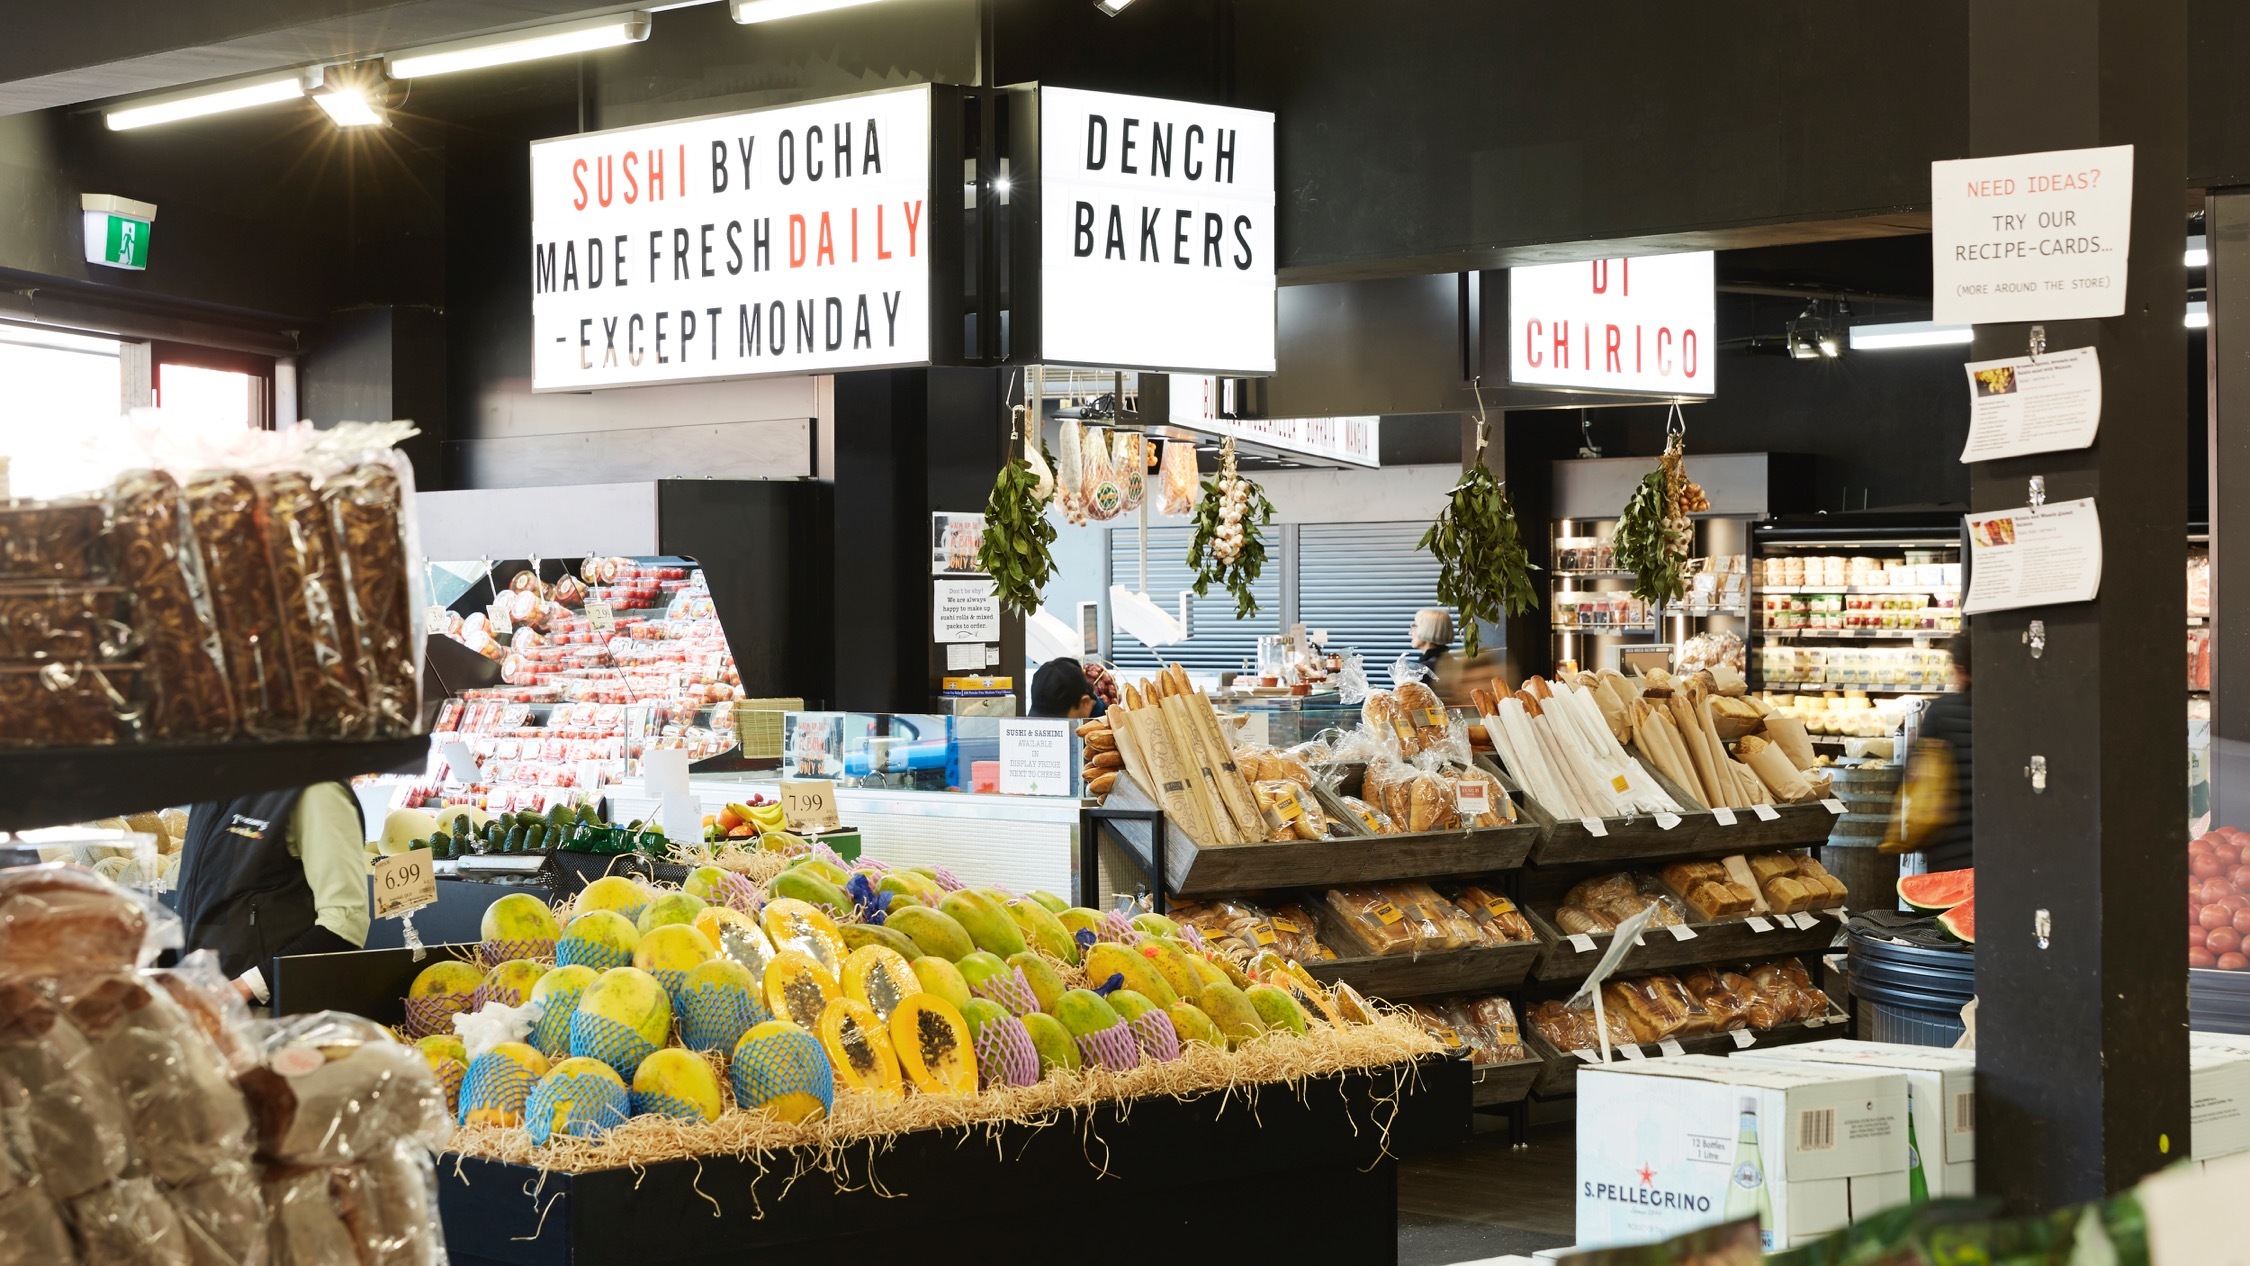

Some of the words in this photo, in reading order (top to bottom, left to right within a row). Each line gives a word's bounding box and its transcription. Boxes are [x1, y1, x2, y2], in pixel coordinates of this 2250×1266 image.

[1086, 113, 1235, 184] DENCH
[573, 143, 687, 212] SUSHI
[712, 135, 756, 194] BY
[777, 117, 882, 185] OCHA
[1967, 179, 2015, 198] NEED
[2027, 169, 2101, 193] IDEAS?
[1992, 214, 2027, 231] TRY
[2038, 210, 2076, 229] OUR
[1073, 200, 1253, 271] BAKERS
[536, 233, 628, 295] MADE
[650, 213, 772, 284] FRESH
[788, 200, 924, 269] DAILY
[1956, 284, 1989, 297] (MORE
[1994, 282, 2037, 293] AROUND
[2044, 280, 2064, 290] THE
[2072, 276, 2111, 290] STORE)
[739, 290, 900, 358] MONDAY
[1526, 317, 1697, 379] CHIRICO
[1006, 729, 1026, 737] SUSHI
[1028, 729, 1033, 737] &
[1034, 729, 1063, 738] SASHIMI
[1018, 740, 1052, 748] AVAILABLE
[1010, 760, 1036, 768] DISPLAY
[1038, 760, 1061, 768] FRIDGE
[1031, 750, 1039, 758] IN
[1028, 770, 1036, 778] TO
[1037, 771, 1061, 779] CHEESE
[789, 793, 823, 811] 7.99
[385, 863, 420, 890] 6.99
[1692, 1138, 1700, 1148] 12
[1702, 1139, 1725, 1150] Bottles
[1704, 1150, 1719, 1160] Litre
[1584, 1181, 1711, 1212] S.PELLEGRINO
